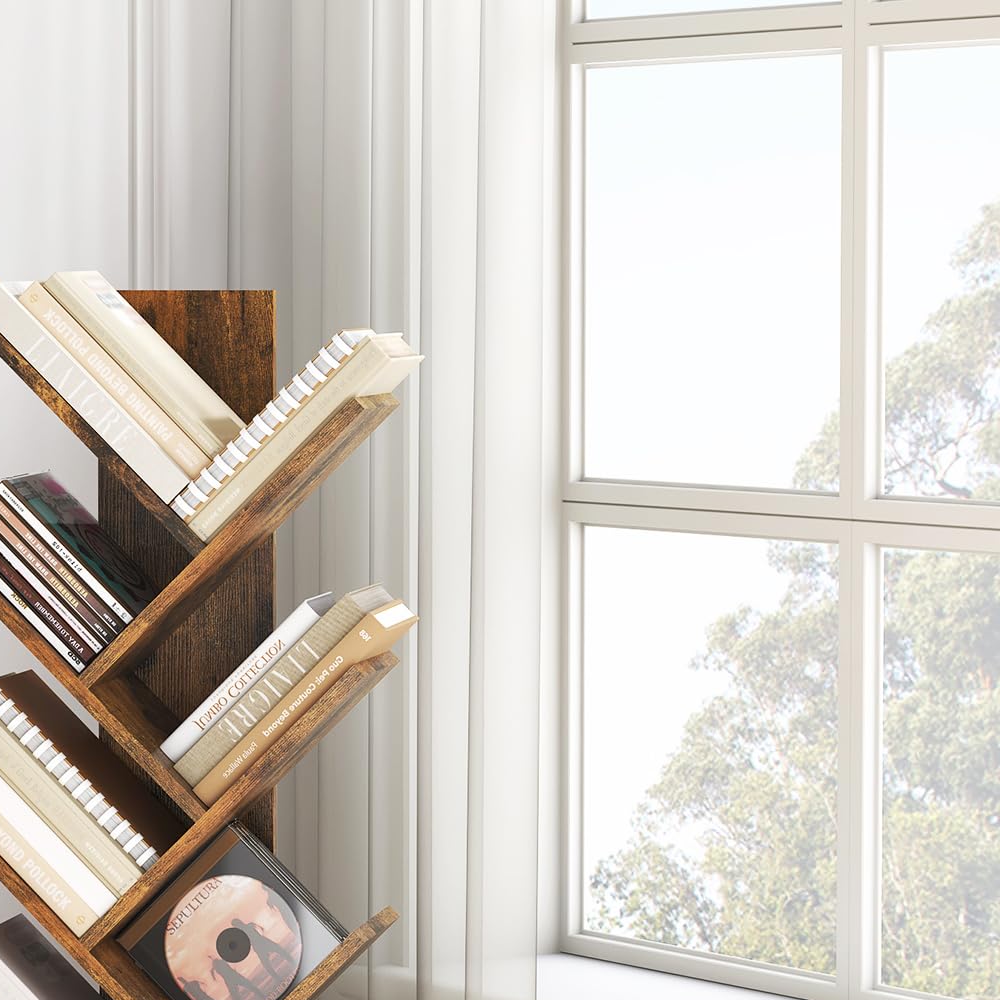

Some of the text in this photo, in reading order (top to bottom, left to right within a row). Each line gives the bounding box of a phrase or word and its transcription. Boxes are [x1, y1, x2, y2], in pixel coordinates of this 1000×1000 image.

[41, 306, 174, 443] PAINTING BEYOND POLLOCK
[20, 857, 72, 911] POLLOCK
[164, 873, 223, 936] SEPULTURA
